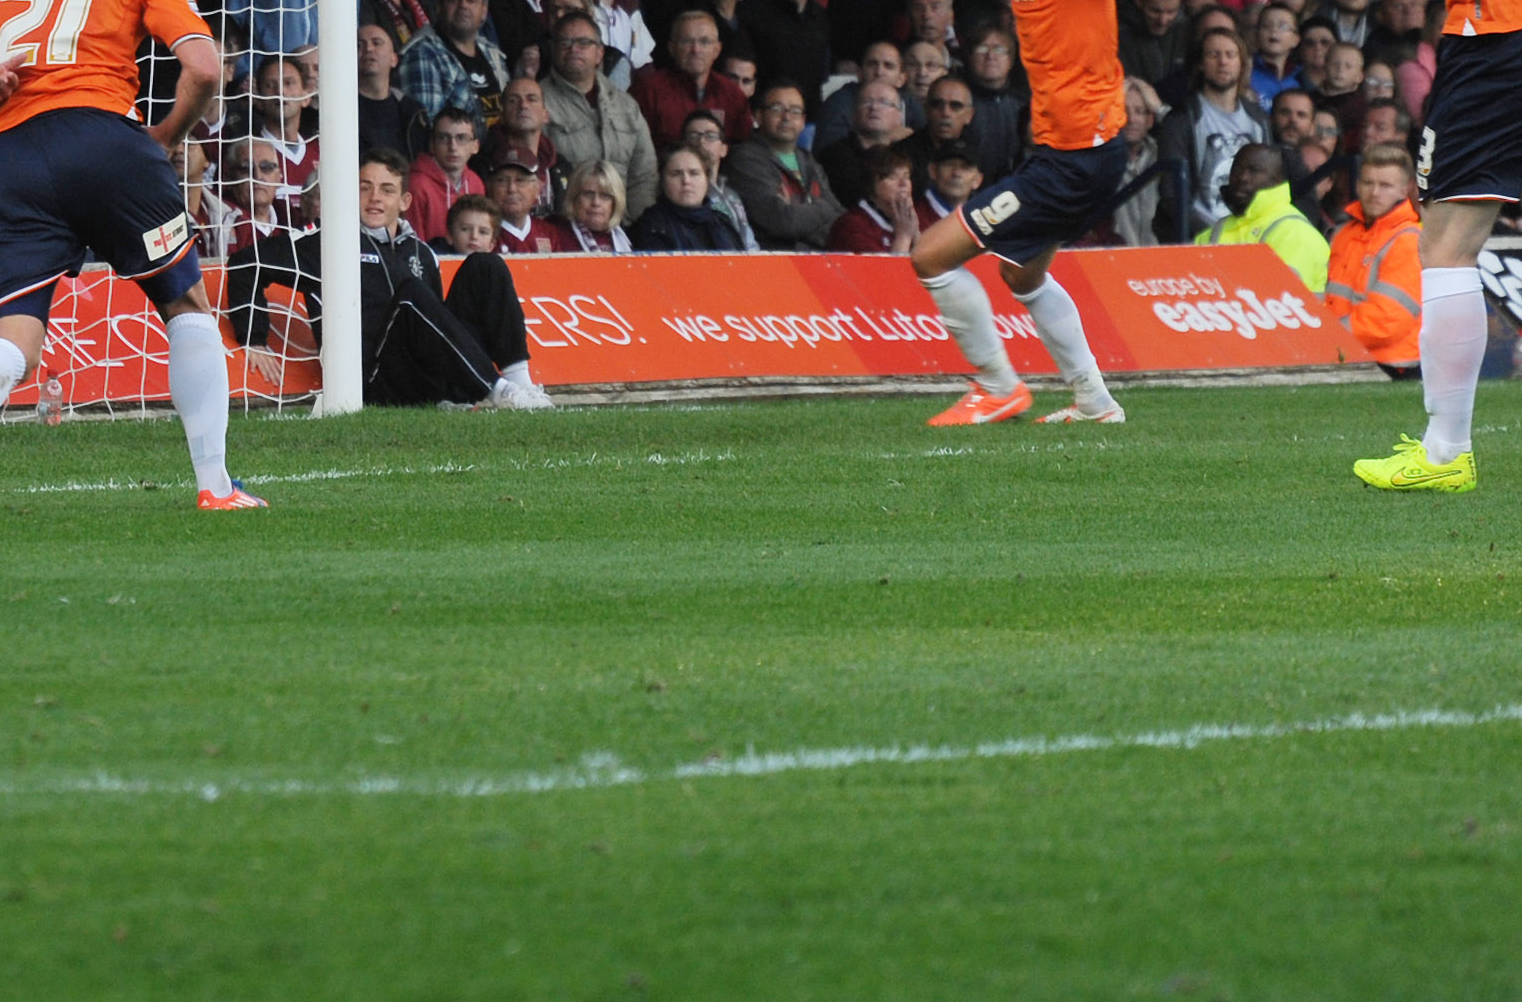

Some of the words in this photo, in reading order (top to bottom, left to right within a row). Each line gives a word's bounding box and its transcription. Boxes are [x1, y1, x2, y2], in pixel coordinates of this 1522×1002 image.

[982, 190, 1022, 225] 9
[1127, 277, 1199, 299] europe
[1188, 271, 1226, 298] by
[517, 295, 647, 348] ERS!
[662, 314, 729, 342] we
[724, 307, 854, 349] support
[855, 306, 949, 342] Luto
[992, 313, 1040, 340] ow
[1152, 286, 1322, 340] easyJet
